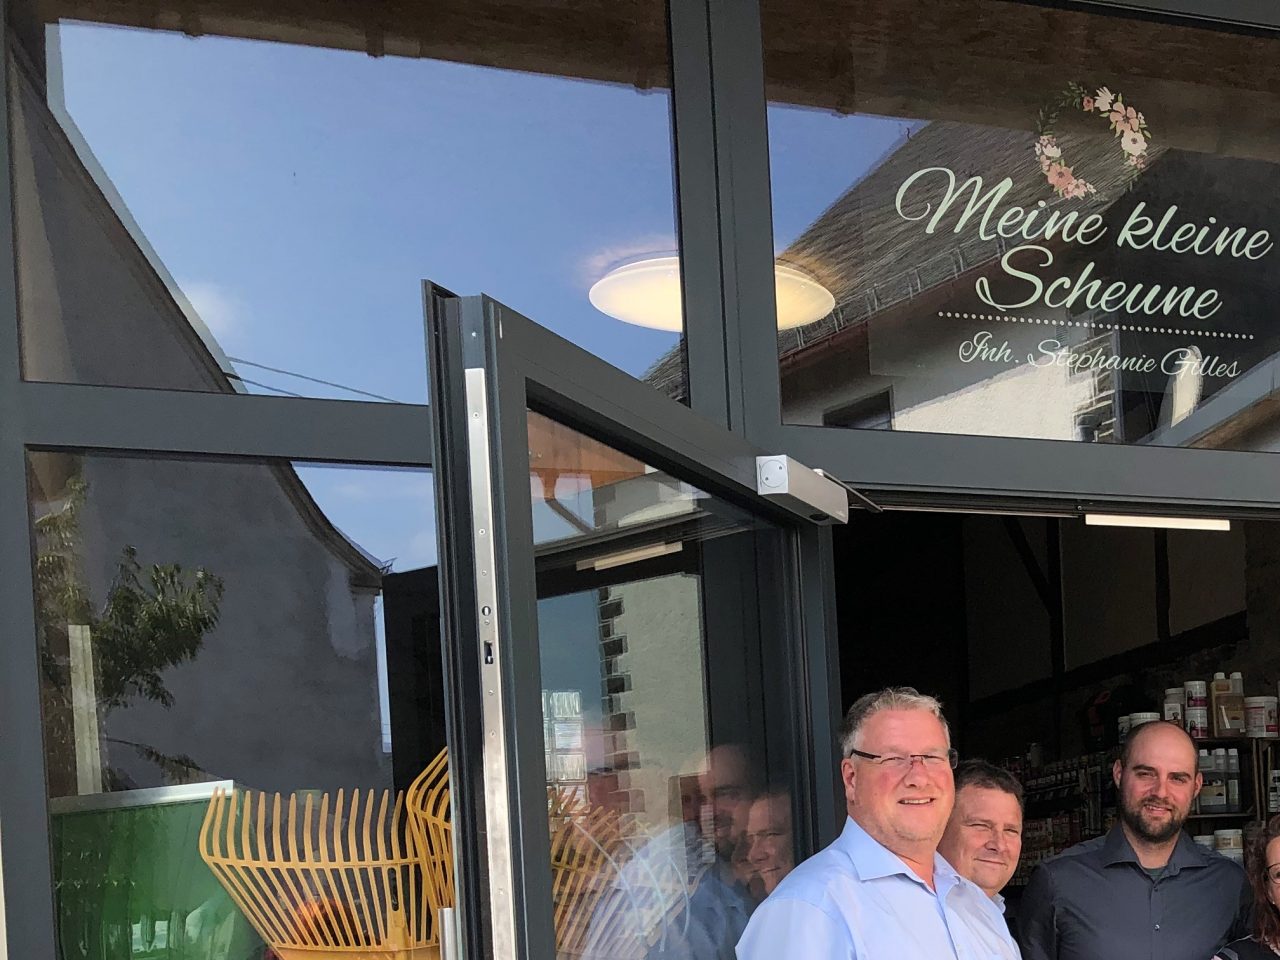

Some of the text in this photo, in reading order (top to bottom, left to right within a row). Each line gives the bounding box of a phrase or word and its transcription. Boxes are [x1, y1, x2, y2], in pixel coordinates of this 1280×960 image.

[895, 167, 1273, 260] Meine kleine
[976, 245, 1223, 320] Scheune
[958, 331, 1241, 378] Inh. Stephanie Gilles
